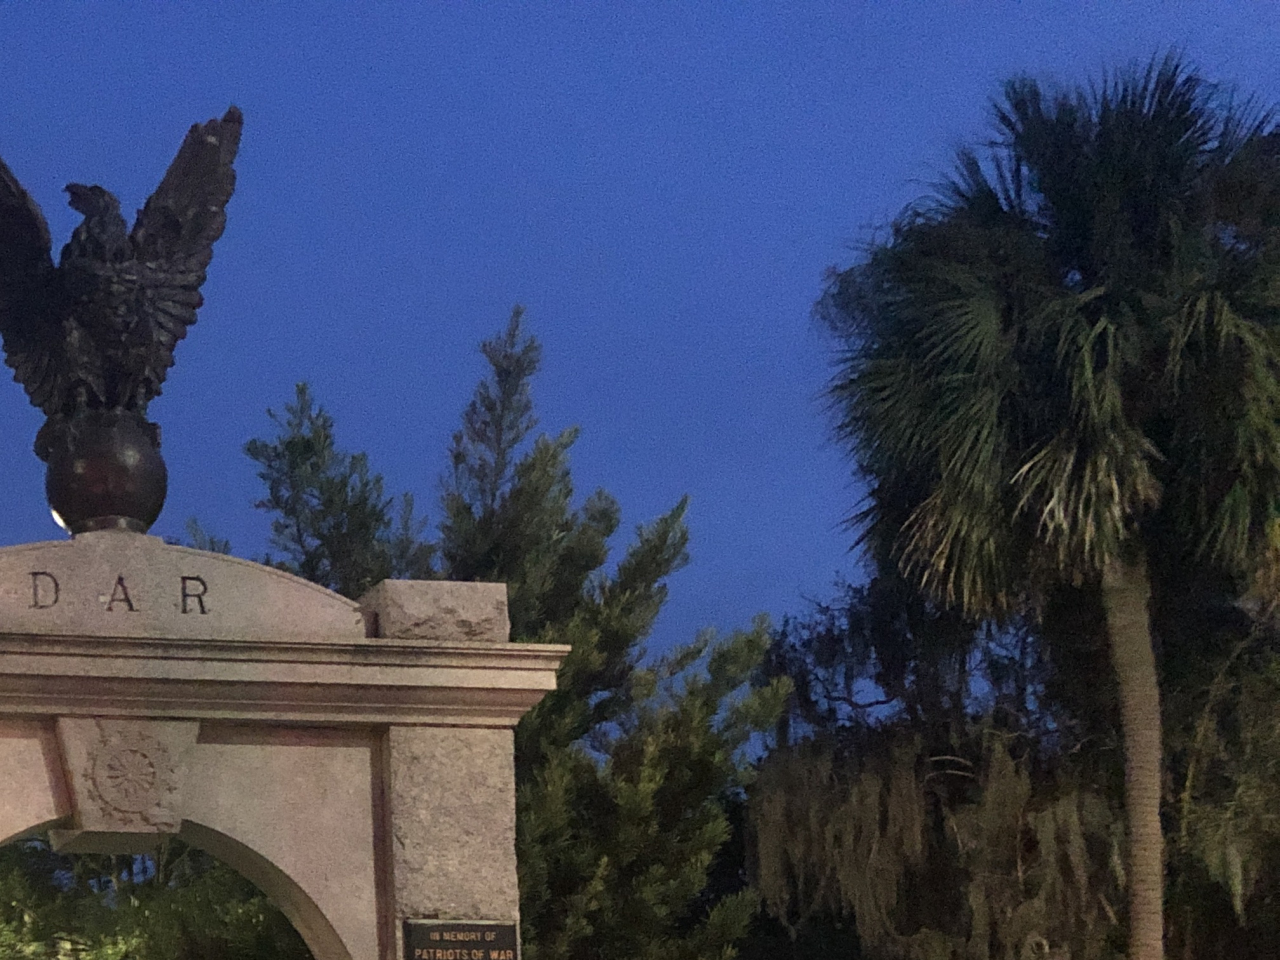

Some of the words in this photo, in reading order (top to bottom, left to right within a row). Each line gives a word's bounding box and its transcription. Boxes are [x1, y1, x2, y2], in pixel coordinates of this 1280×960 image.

[429, 931, 440, 941] IN
[442, 931, 481, 942] MEMORY
[484, 931, 497, 941] OF
[414, 948, 469, 960] PATRIOTS
[471, 949, 485, 960] OF
[489, 949, 515, 960] WAR
